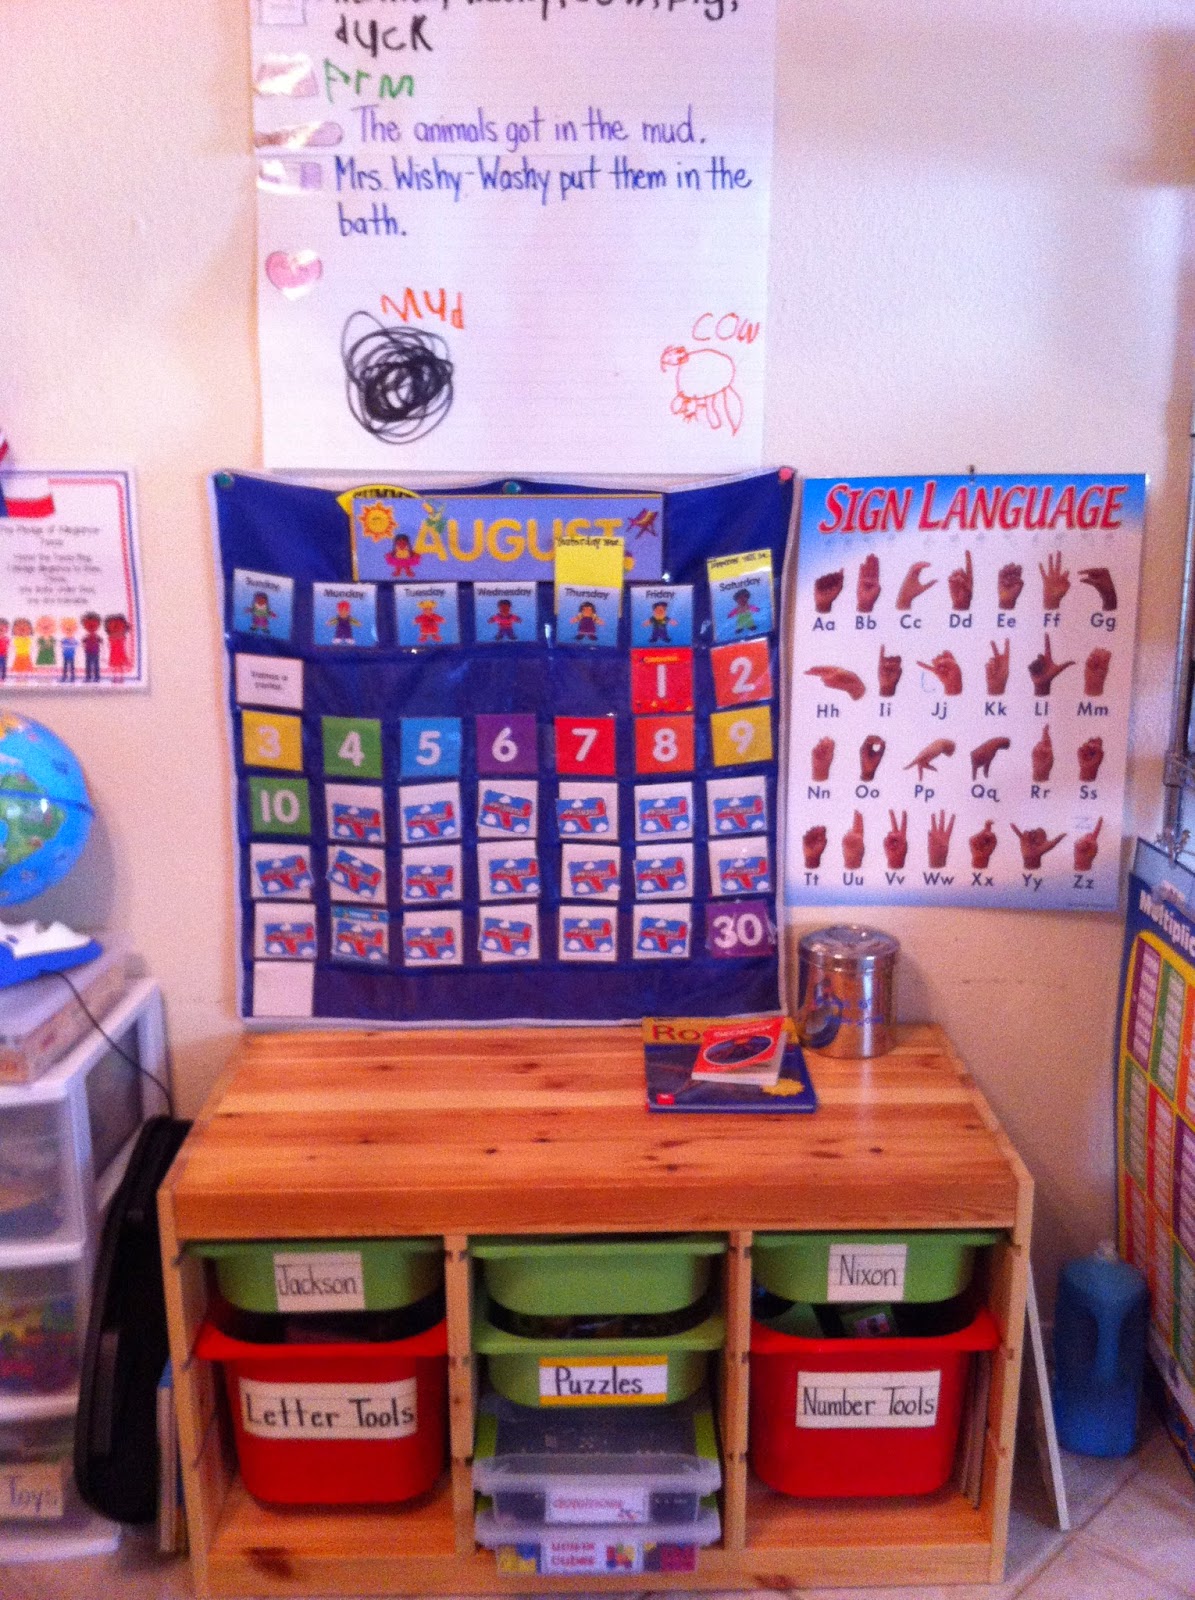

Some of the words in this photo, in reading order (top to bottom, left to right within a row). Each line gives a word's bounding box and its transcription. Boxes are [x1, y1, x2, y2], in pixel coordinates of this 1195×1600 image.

[351, 104, 401, 142] The
[414, 107, 498, 143] animals
[506, 106, 545, 153] got
[555, 120, 577, 142] in
[582, 106, 629, 141] the
[642, 103, 706, 143] mud.
[560, 155, 602, 200] put
[608, 155, 667, 190] them
[676, 161, 701, 191] in
[705, 156, 753, 190] the
[338, 202, 407, 237] bath.
[818, 483, 913, 534] SIGN
[918, 480, 1128, 532] LANGUAGE
[324, 588, 365, 600] Monday
[404, 587, 445, 598] Tuesday
[476, 587, 532, 598] Wednesday
[565, 588, 610, 600] Thursday
[646, 590, 675, 600] Friday
[719, 577, 761, 592] Saturday
[812, 617, 836, 631] Aa
[855, 616, 877, 630] Bb
[900, 615, 922, 630] Cc
[949, 614, 973, 629] Dd
[997, 614, 1017, 629] Ee
[1043, 614, 1061, 629] Ff
[1090, 614, 1117, 632] Gg
[656, 664, 666, 698] 1
[729, 656, 756, 693] 2
[816, 704, 840, 718] Hh
[879, 703, 892, 717] Ii
[931, 702, 948, 720] Jj
[984, 702, 1008, 717] Kk
[1076, 702, 1109, 717] Mm
[256, 725, 282, 760] 3
[337, 731, 365, 767] 4
[416, 730, 442, 766] 5
[491, 727, 518, 763] 6
[571, 728, 598, 762] 7
[652, 728, 678, 763] 8
[729, 720, 756, 755] 9
[259, 789, 299, 824] 10
[807, 786, 831, 800] Nn
[855, 785, 880, 799] Oo
[914, 785, 935, 802] Pp
[970, 785, 999, 802] Qq
[1030, 785, 1050, 799] Rr
[1079, 785, 1098, 799] Ss
[803, 873, 819, 886] Tt
[842, 873, 864, 886] Uu
[885, 872, 905, 886] Vv
[923, 873, 955, 886] Ww
[970, 873, 993, 887] Xx
[1021, 874, 1043, 891] Yy
[1073, 875, 1094, 890] Zz
[712, 913, 762, 949] 30
[276, 1263, 357, 1296] Jackson
[839, 1254, 897, 1286] Nixon
[555, 1366, 643, 1396] Puzzles
[245, 1392, 340, 1428] Letter
[347, 1396, 414, 1428] Tools
[803, 1386, 875, 1416] Number
[882, 1386, 935, 1415] Tools
